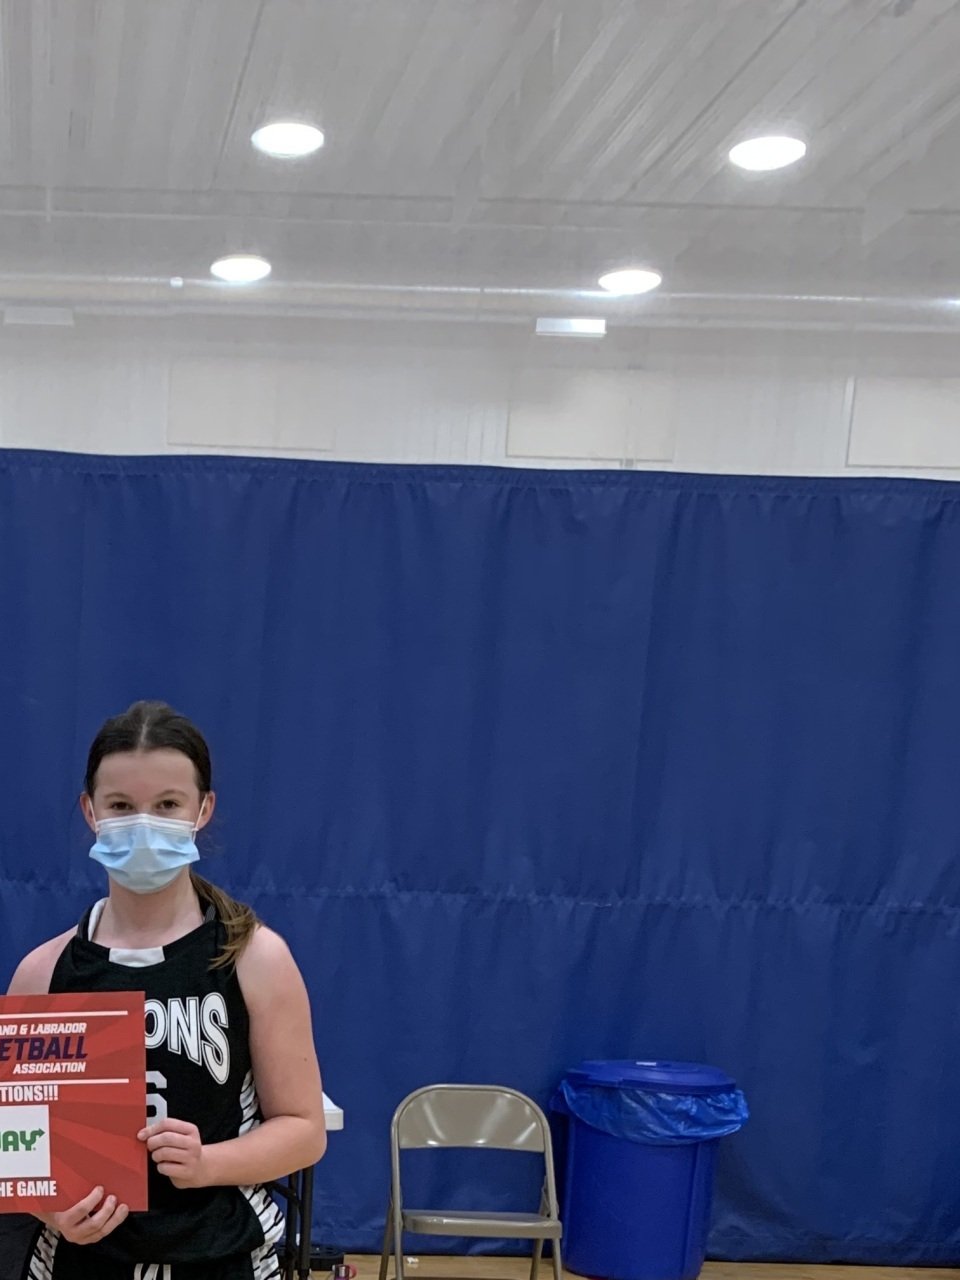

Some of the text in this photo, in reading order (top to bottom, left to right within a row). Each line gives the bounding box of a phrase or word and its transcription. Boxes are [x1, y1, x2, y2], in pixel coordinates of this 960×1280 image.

[19, 1024, 28, 1036] &
[29, 1022, 87, 1036] LABRADOR
[12, 1062, 87, 1075] ASSOCIATION
[17, 1180, 57, 1197] GAME
